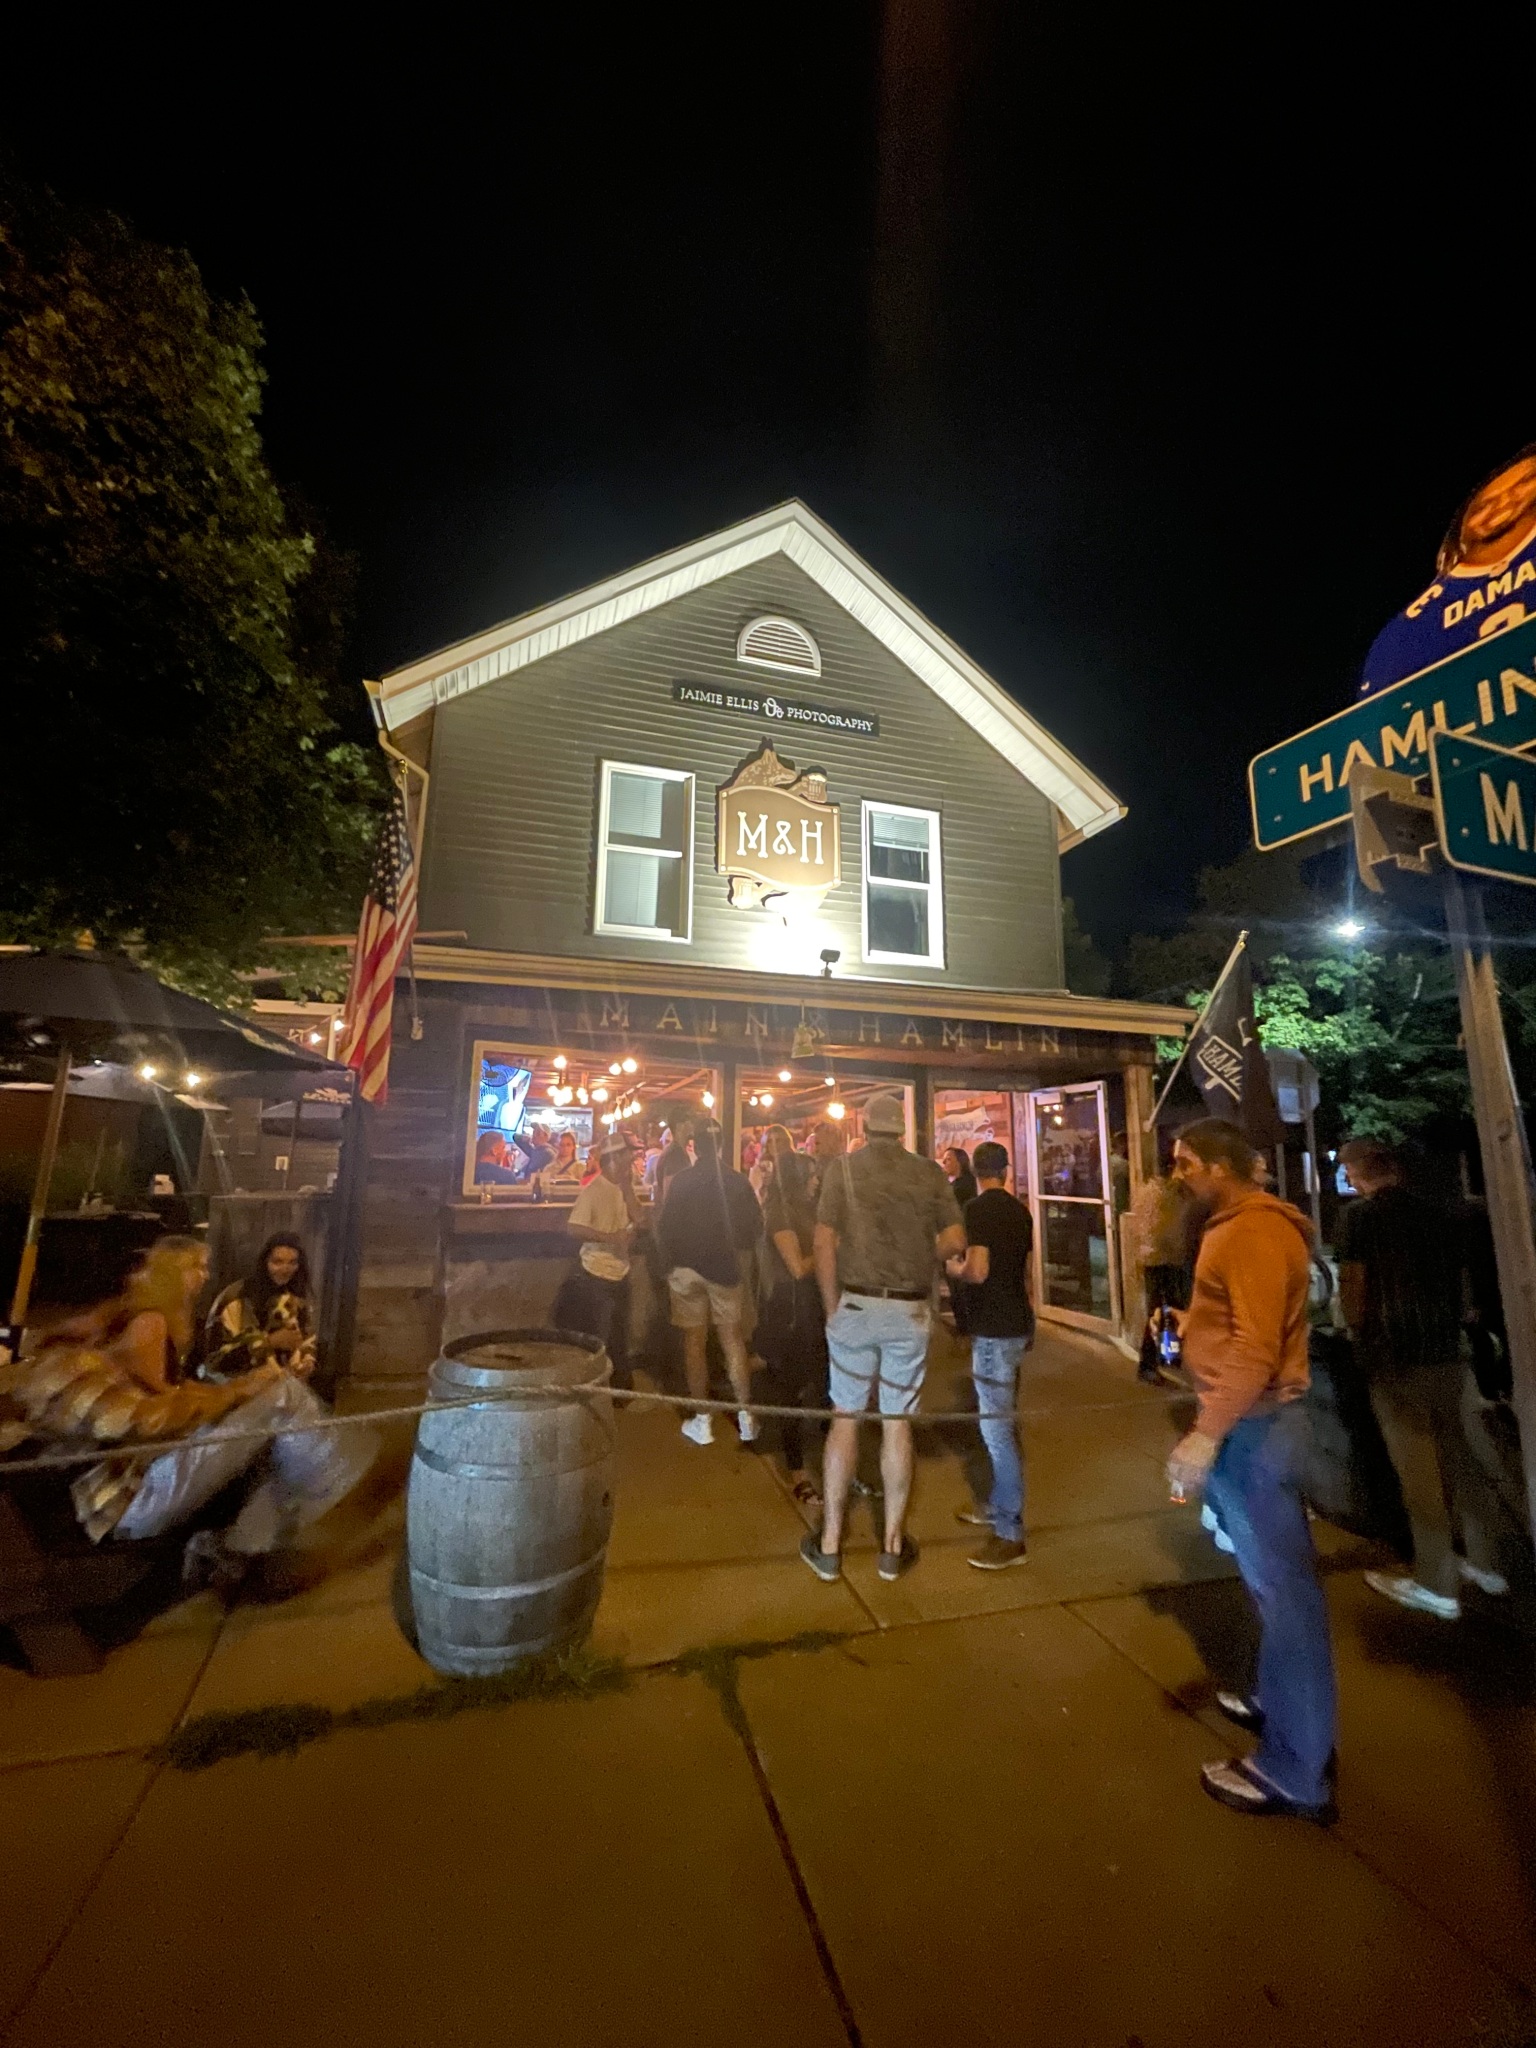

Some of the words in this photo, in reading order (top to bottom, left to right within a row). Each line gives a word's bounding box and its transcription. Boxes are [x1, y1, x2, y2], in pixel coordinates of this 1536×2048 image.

[680, 687, 722, 705] JAIMIE
[726, 696, 759, 711] ELLIS
[787, 707, 873, 732] PHOTOGRAPHY
[736, 811, 824, 865] M&H
[1480, 772, 1536, 854] M
[599, 1000, 769, 1037] MAIN
[858, 1015, 1061, 1053] HAMLIN
